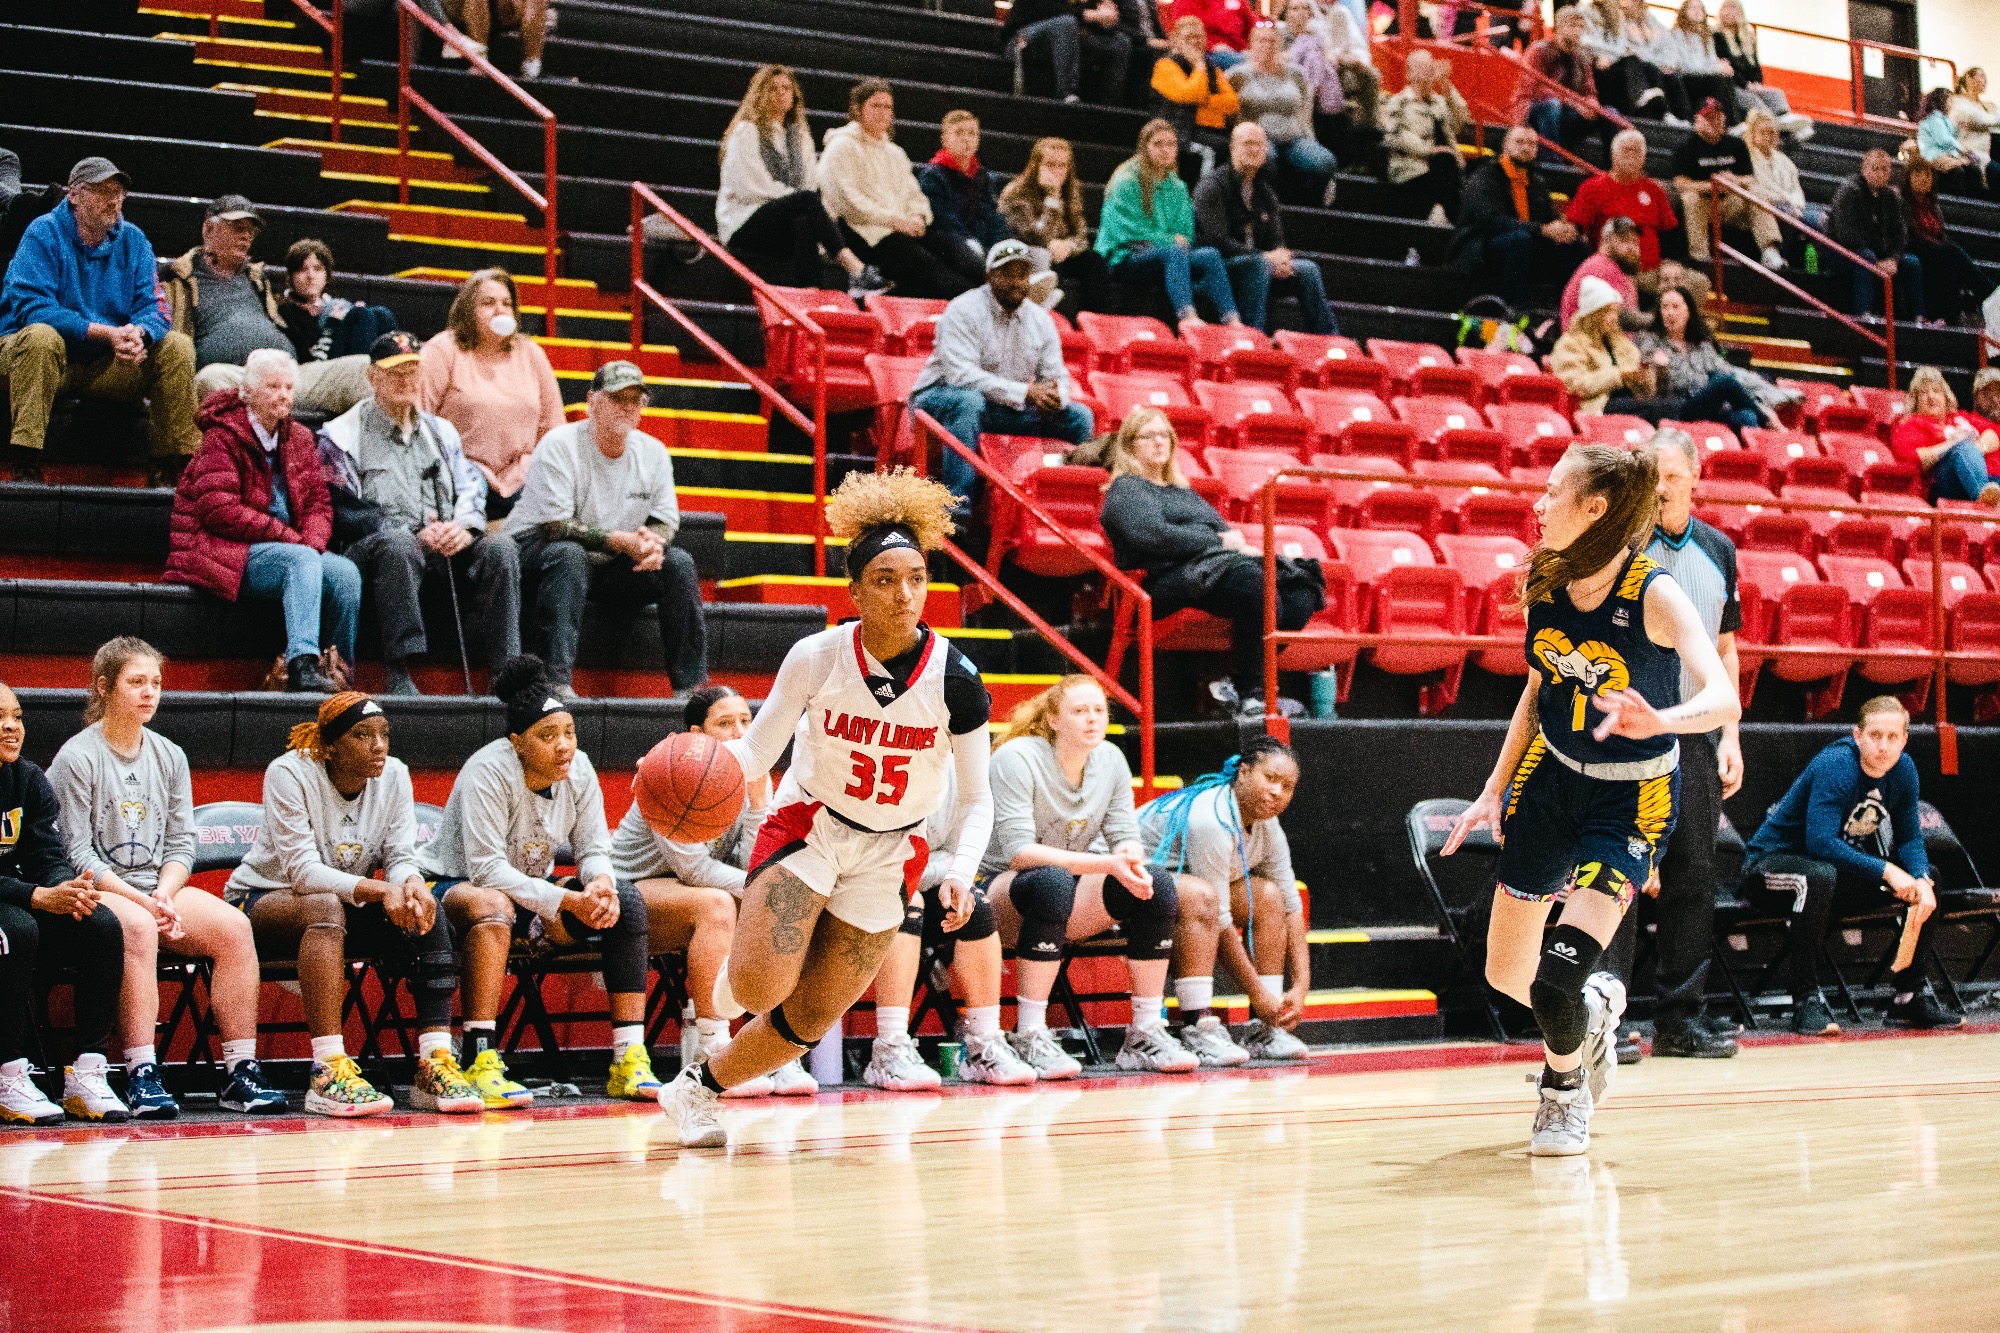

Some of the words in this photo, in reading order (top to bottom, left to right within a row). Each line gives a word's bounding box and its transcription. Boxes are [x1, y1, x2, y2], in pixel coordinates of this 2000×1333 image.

[823, 708, 882, 746] LADY
[878, 721, 939, 752] LIONS
[844, 750, 912, 806] 35
